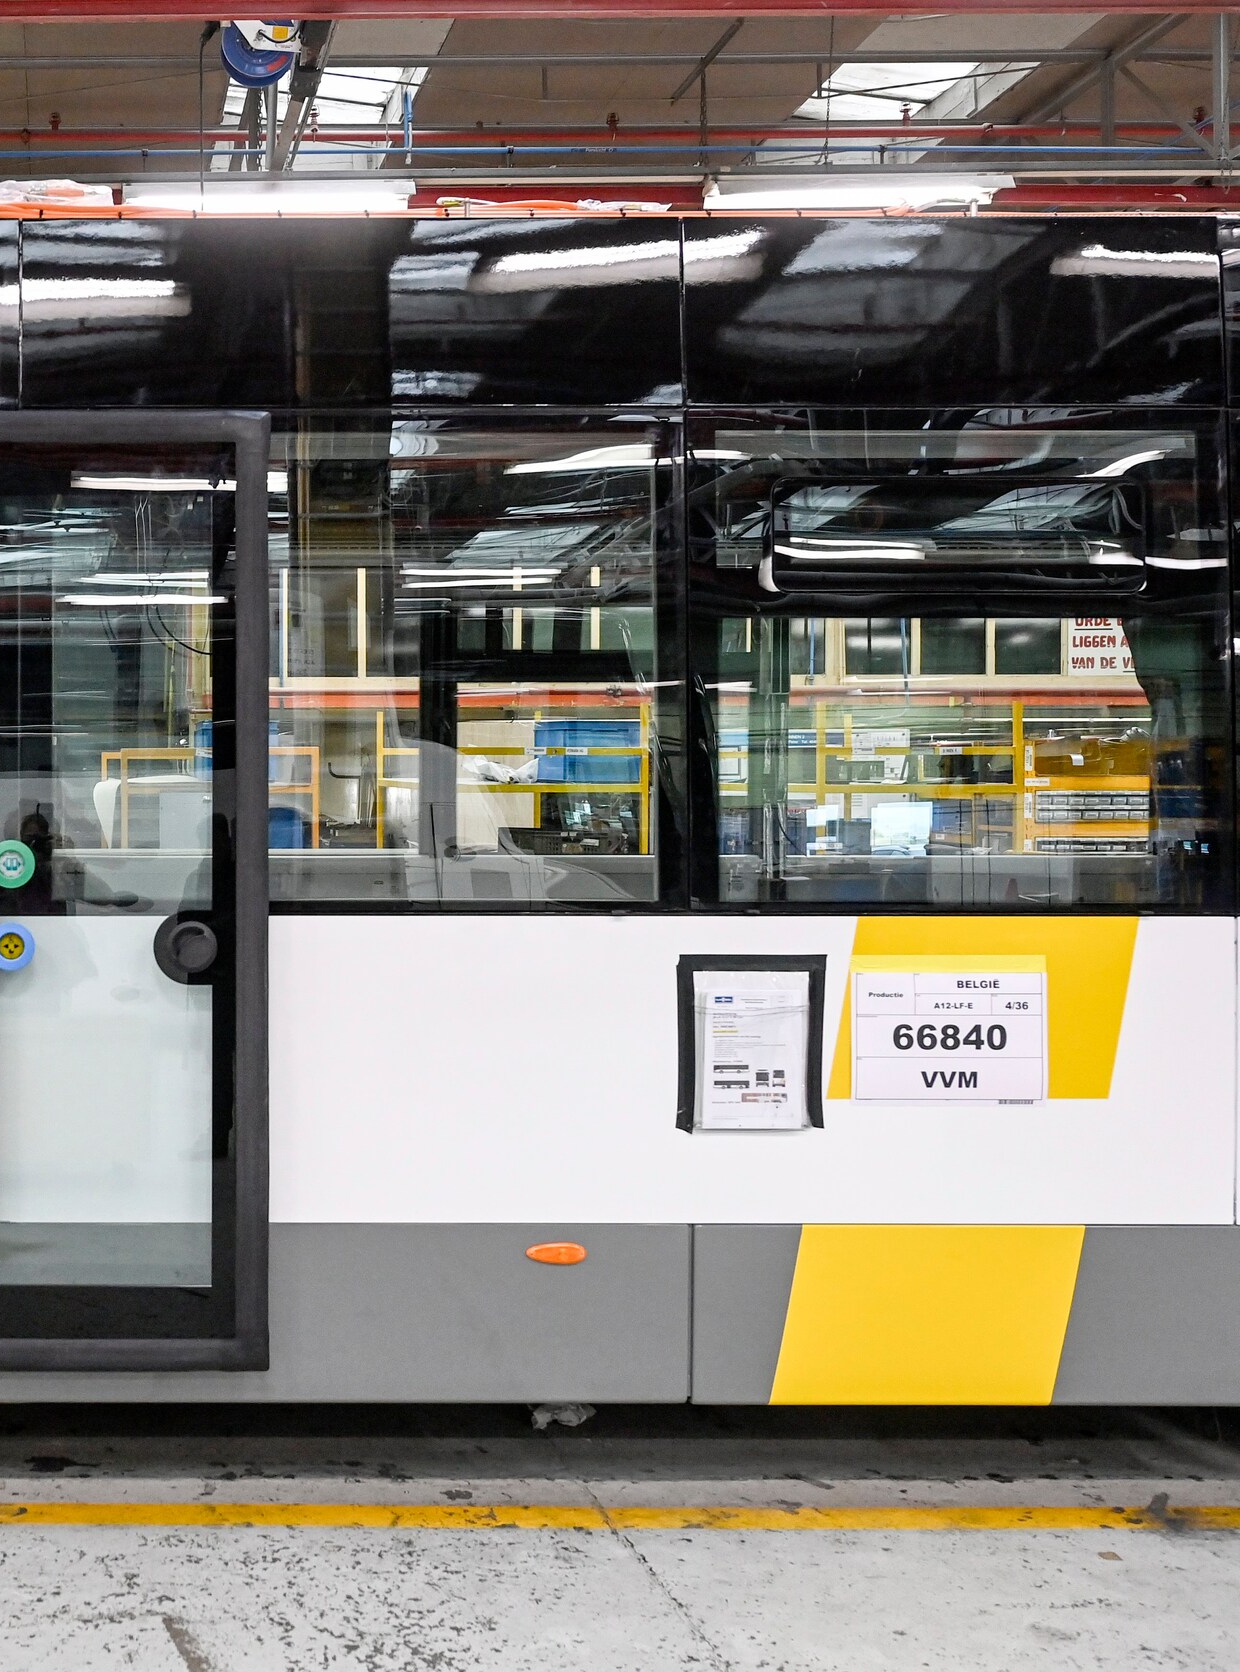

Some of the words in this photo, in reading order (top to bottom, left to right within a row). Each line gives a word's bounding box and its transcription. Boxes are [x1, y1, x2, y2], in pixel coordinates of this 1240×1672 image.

[1072, 635, 1116, 648] LIGGEN
[1071, 656, 1095, 669] VAN
[1100, 656, 1117, 669] DE
[956, 978, 1001, 989] BELGIË
[933, 1001, 974, 1009] A12-LF-E
[1004, 1001, 1029, 1010] 4/36
[892, 1023, 1008, 1051] 66840
[920, 1070, 979, 1089] VVM
